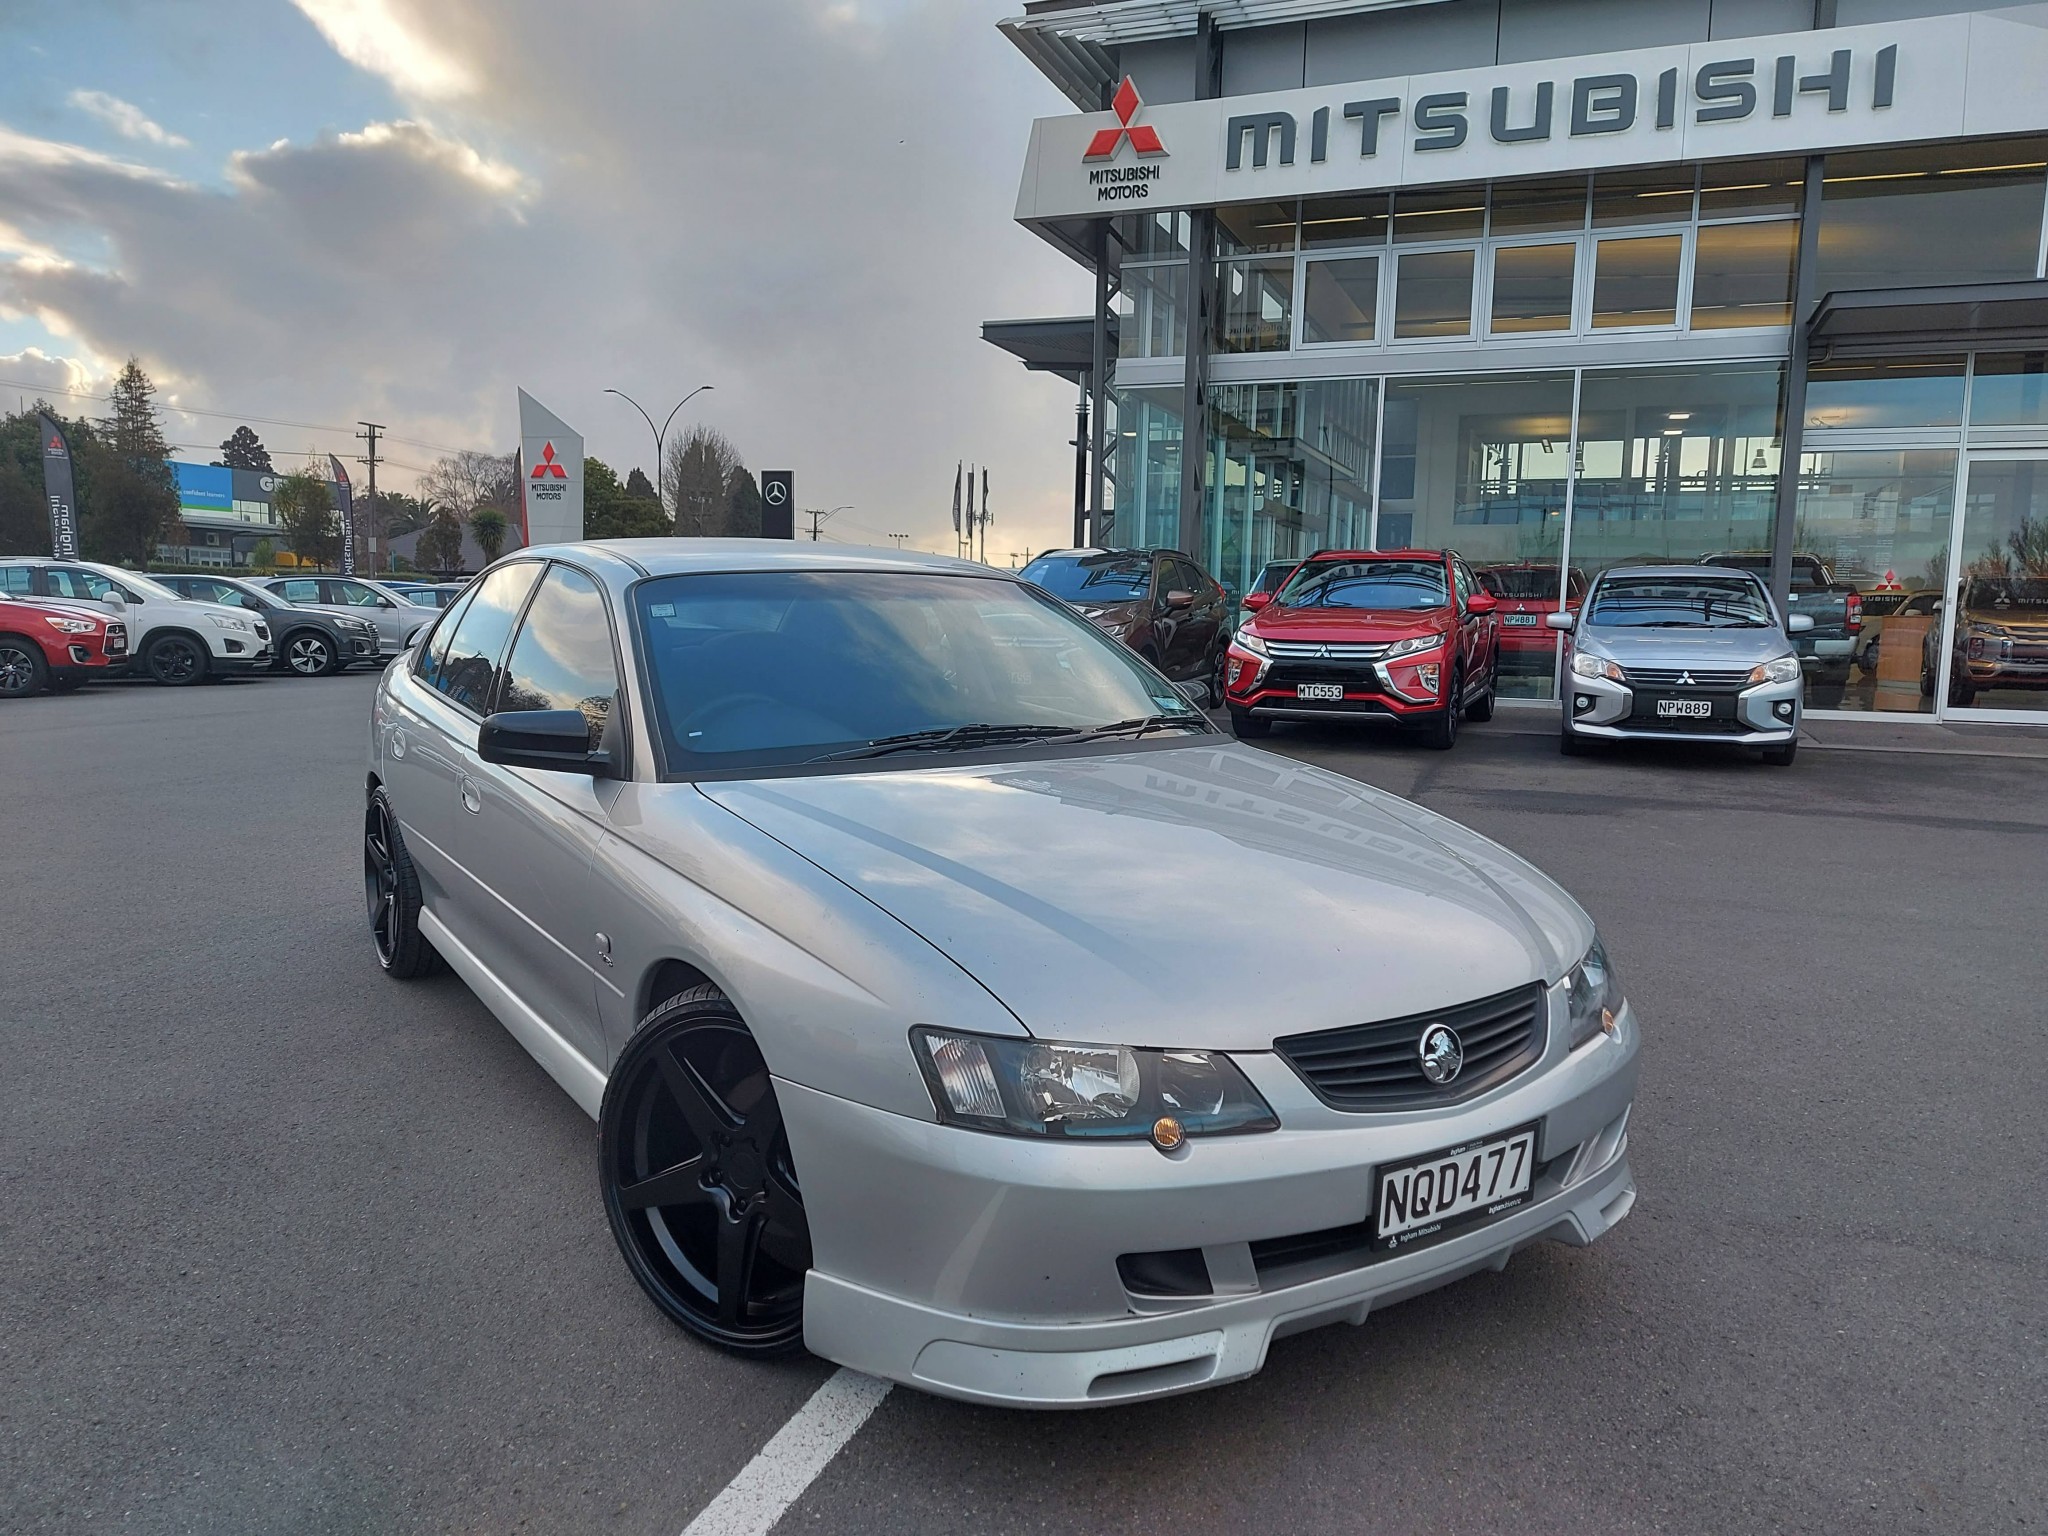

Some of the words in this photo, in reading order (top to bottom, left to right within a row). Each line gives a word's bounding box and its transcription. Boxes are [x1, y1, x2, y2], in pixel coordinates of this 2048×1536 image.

[1226, 43, 1898, 171] MITSUBISHI
[1089, 165, 1160, 185] MITSUBISHI
[1098, 184, 1149, 201] MOTORS
[531, 484, 567, 492] MITSUBISHI
[1299, 685, 1342, 698] MTC553
[1658, 701, 1710, 715] NPW889
[1383, 1139, 1528, 1229] NQD477
